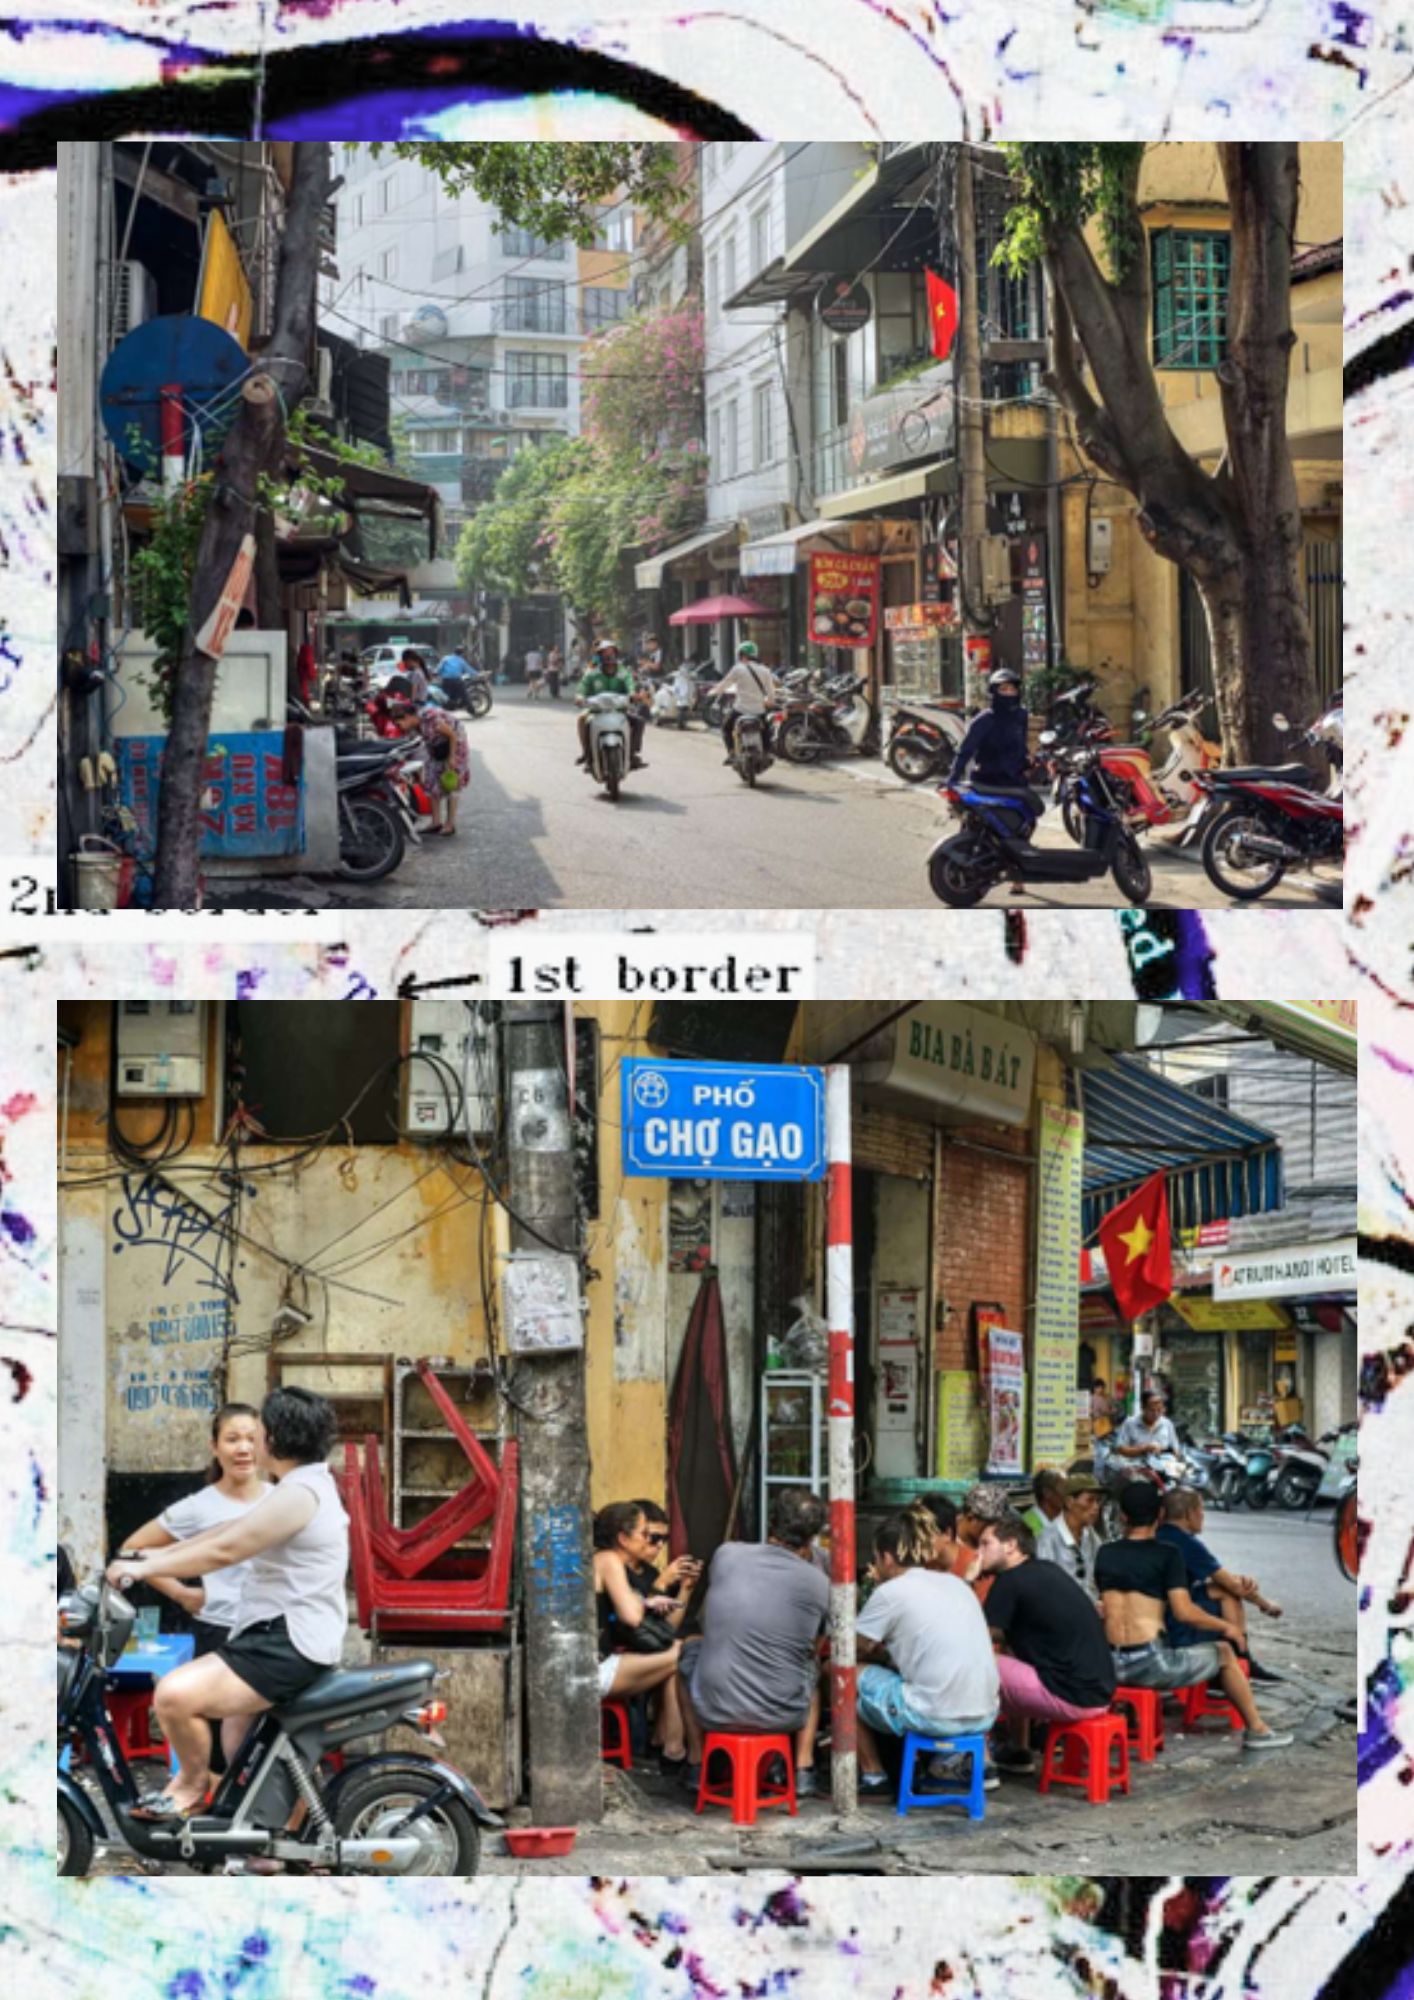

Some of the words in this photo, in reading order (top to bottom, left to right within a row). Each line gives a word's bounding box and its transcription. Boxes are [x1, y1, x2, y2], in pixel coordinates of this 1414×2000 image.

[909, 1020, 945, 1066] BIA
[950, 1029, 974, 1076] BÀ
[980, 1043, 1021, 1090] BÁT
[692, 1079, 755, 1108] PHỐ
[644, 1117, 721, 1166] CHỢ
[731, 1121, 803, 1167] GẠO
[1233, 1264, 1273, 1284] ATRIUM
[1317, 1254, 1356, 1276] HOTEL
